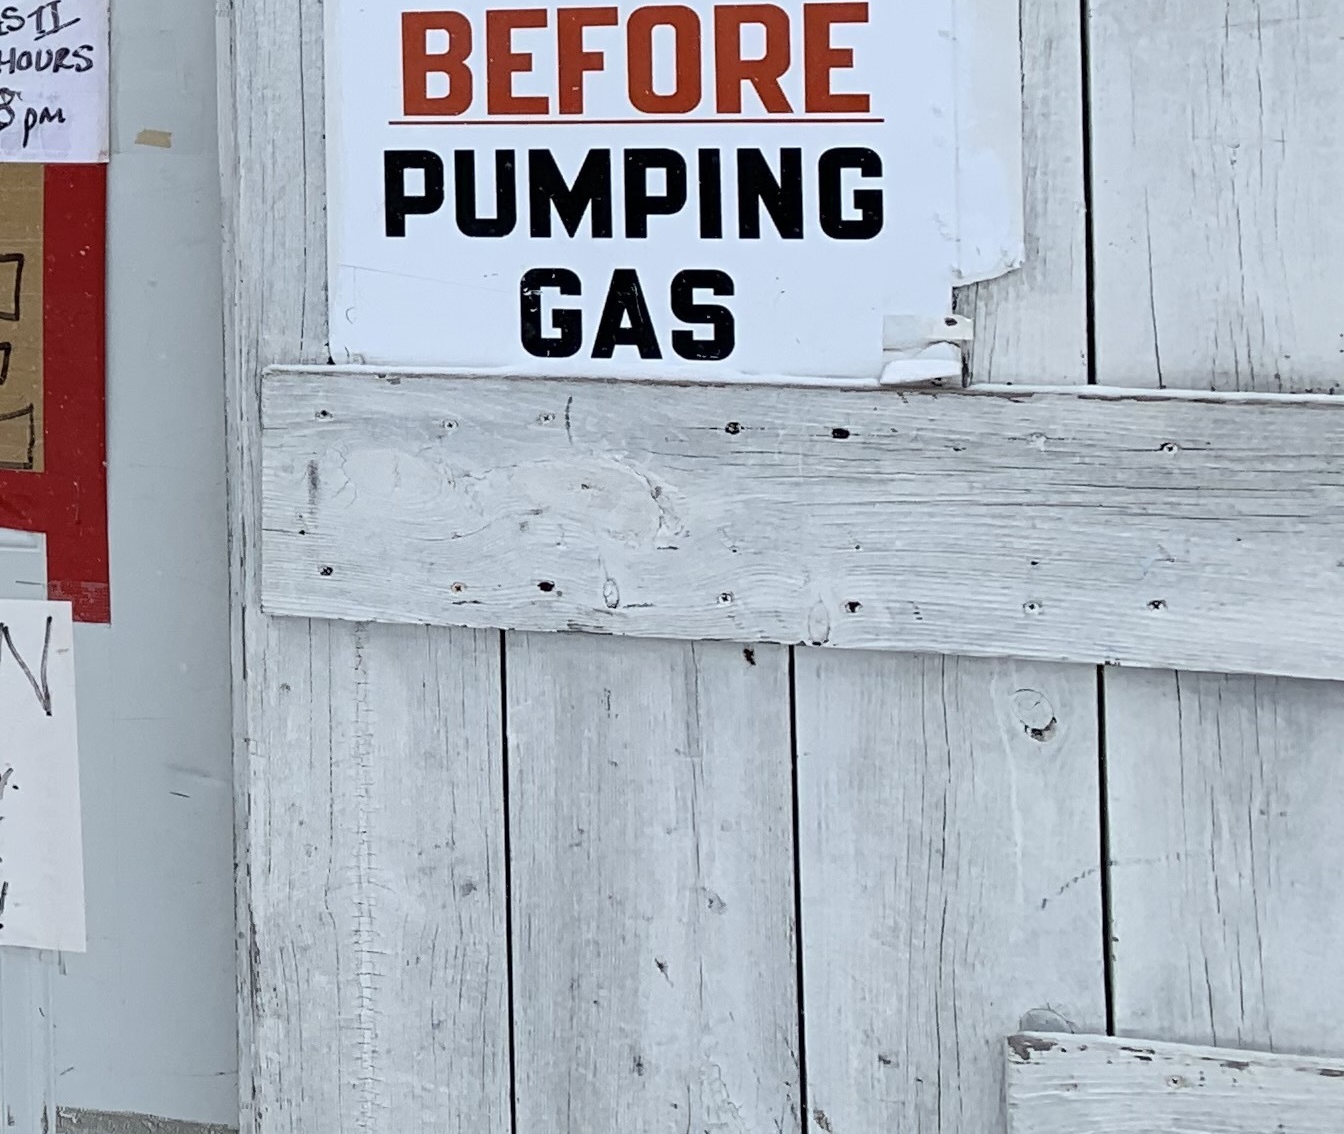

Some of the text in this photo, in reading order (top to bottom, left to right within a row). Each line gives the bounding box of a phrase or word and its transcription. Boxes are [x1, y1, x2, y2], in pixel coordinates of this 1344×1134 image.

[400, 1, 871, 117] BEFORE
[383, 146, 885, 240] PUMPING
[520, 268, 736, 362] GAS
